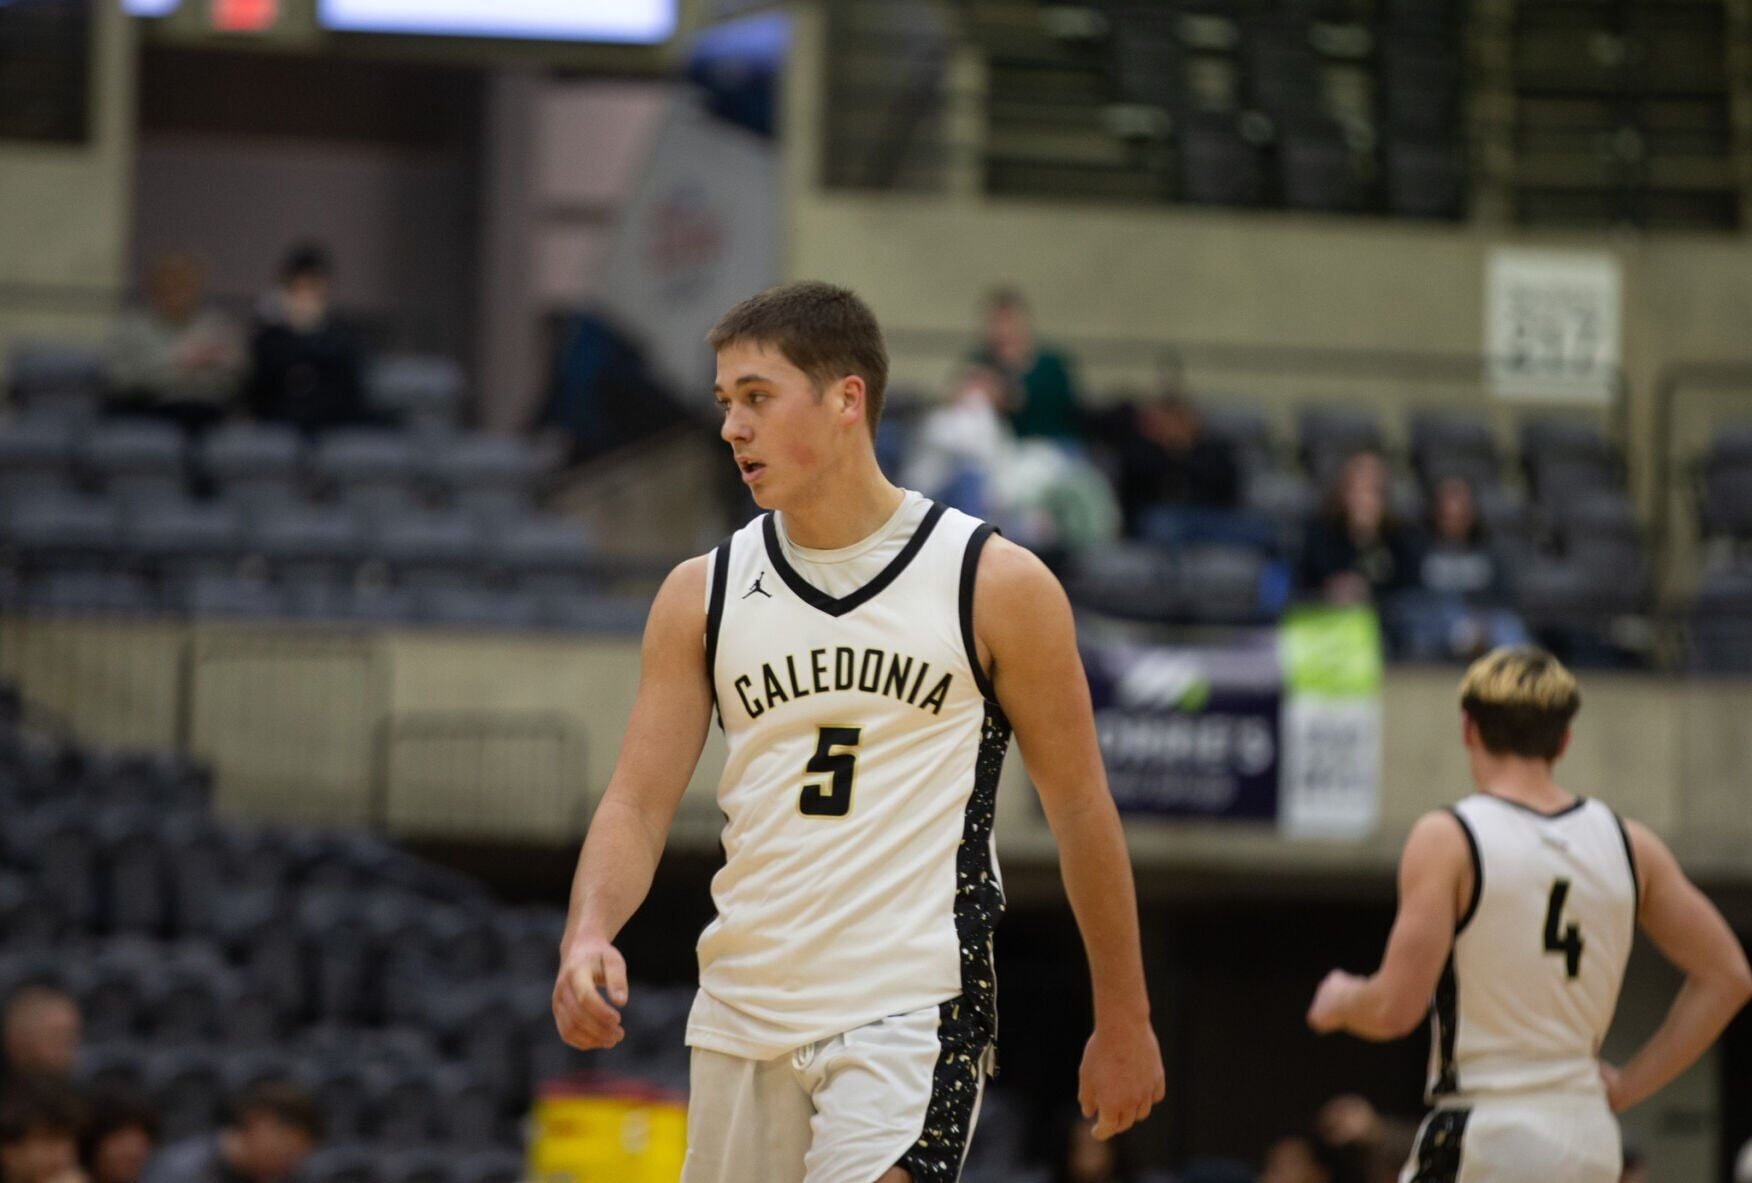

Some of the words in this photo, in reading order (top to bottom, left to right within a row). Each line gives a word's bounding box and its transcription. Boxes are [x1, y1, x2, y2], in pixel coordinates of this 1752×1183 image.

[734, 646, 954, 720] CALEDONIA
[797, 723, 865, 820] 5
[1543, 877, 1585, 982] 4
